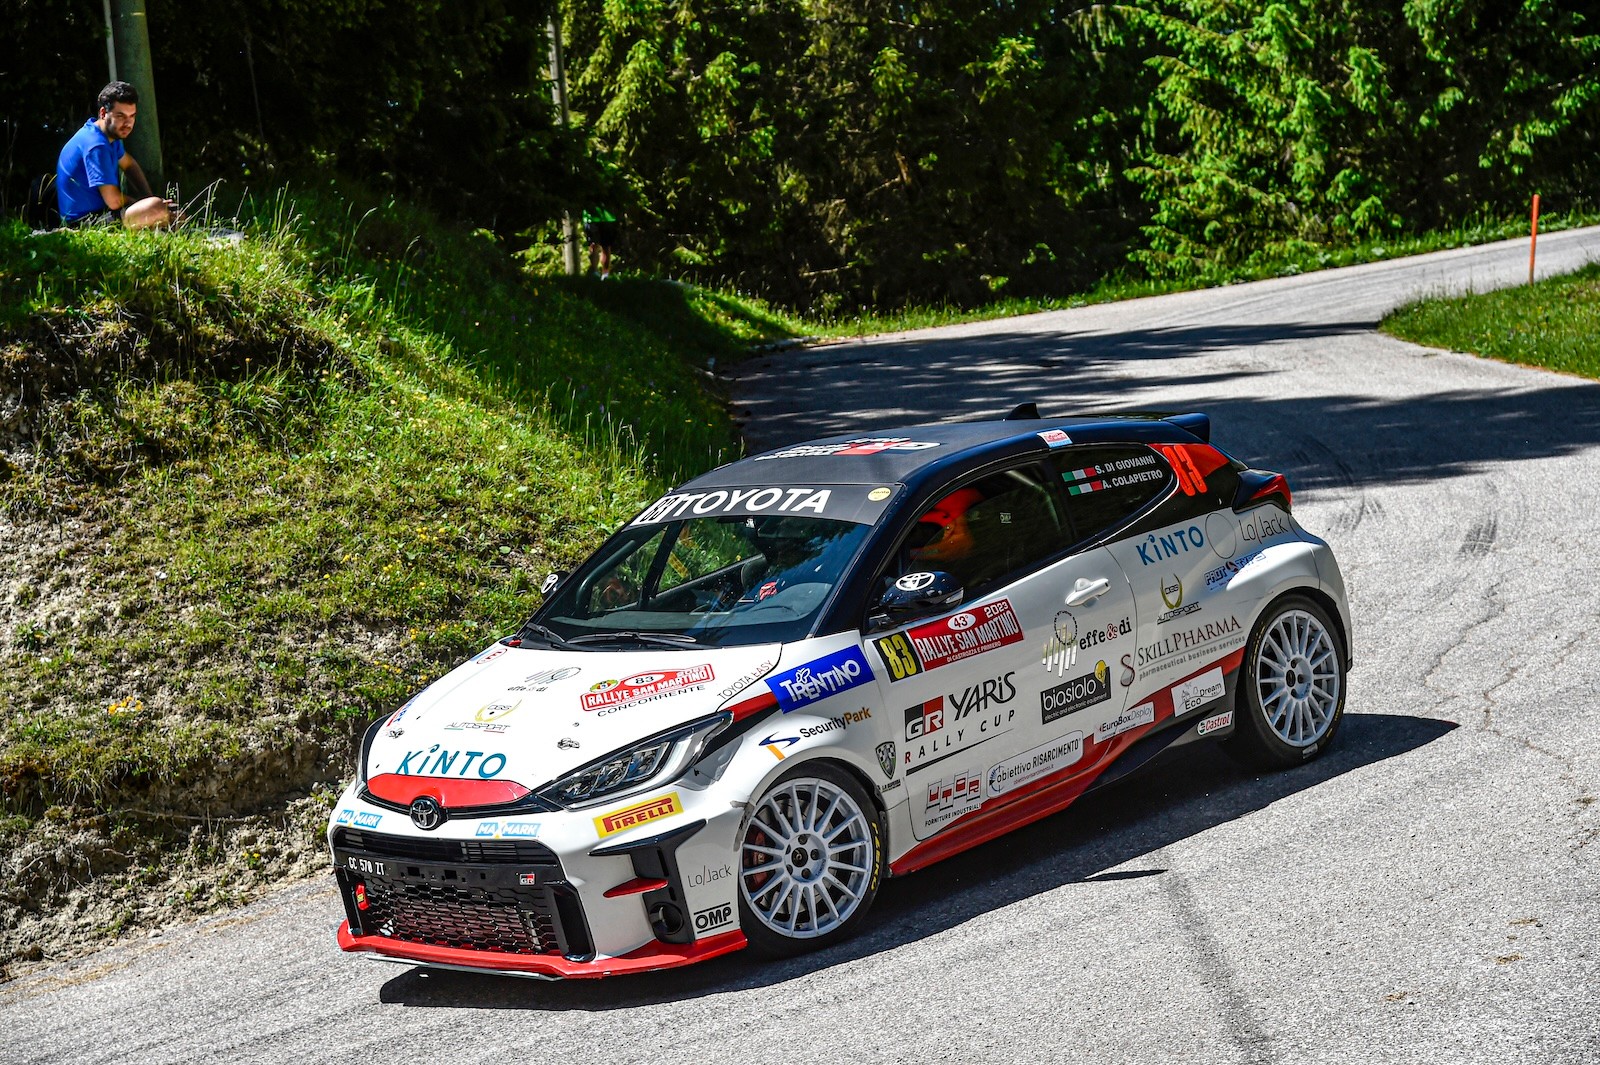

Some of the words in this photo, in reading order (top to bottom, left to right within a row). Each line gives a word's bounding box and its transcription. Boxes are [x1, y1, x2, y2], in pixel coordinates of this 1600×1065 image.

[1096, 464, 1104, 475] S.
[1105, 462, 1116, 473] DI
[1116, 455, 1156, 471] GIOVANNI
[1102, 479, 1112, 490] A.
[1112, 469, 1163, 488] COLAPIETRO
[673, 488, 831, 517] TOYOTA
[984, 601, 1009, 618] 2023
[915, 634, 958, 663] RALLYE
[955, 629, 979, 651] SAN
[976, 610, 1020, 643] MARTINO
[880, 634, 917, 680] 83
[1140, 658, 1187, 681] pharmaceutical
[1188, 647, 1217, 661] business
[1220, 636, 1245, 649] services
[588, 688, 632, 706] RALLYE
[632, 685, 656, 697] SAN
[657, 671, 708, 690] MARTINO
[635, 675, 654, 685] 83
[718, 675, 751, 700] TOYOTA
[753, 660, 774, 678] EASY
[779, 659, 861, 703] TRENTINO
[1043, 677, 1097, 711] biasiolo
[598, 685, 706, 717] CONCORRENTE
[905, 729, 965, 764] RALLY
[980, 709, 1015, 732] CUP
[906, 708, 943, 741] GR
[1206, 714, 1230, 731] Castrol
[996, 762, 1032, 783] obiettivo
[1032, 739, 1079, 769] RISARCIMENTO
[603, 797, 675, 833] PIRELLI
[925, 813, 951, 827] FORNITURE
[695, 906, 732, 929] OMP
